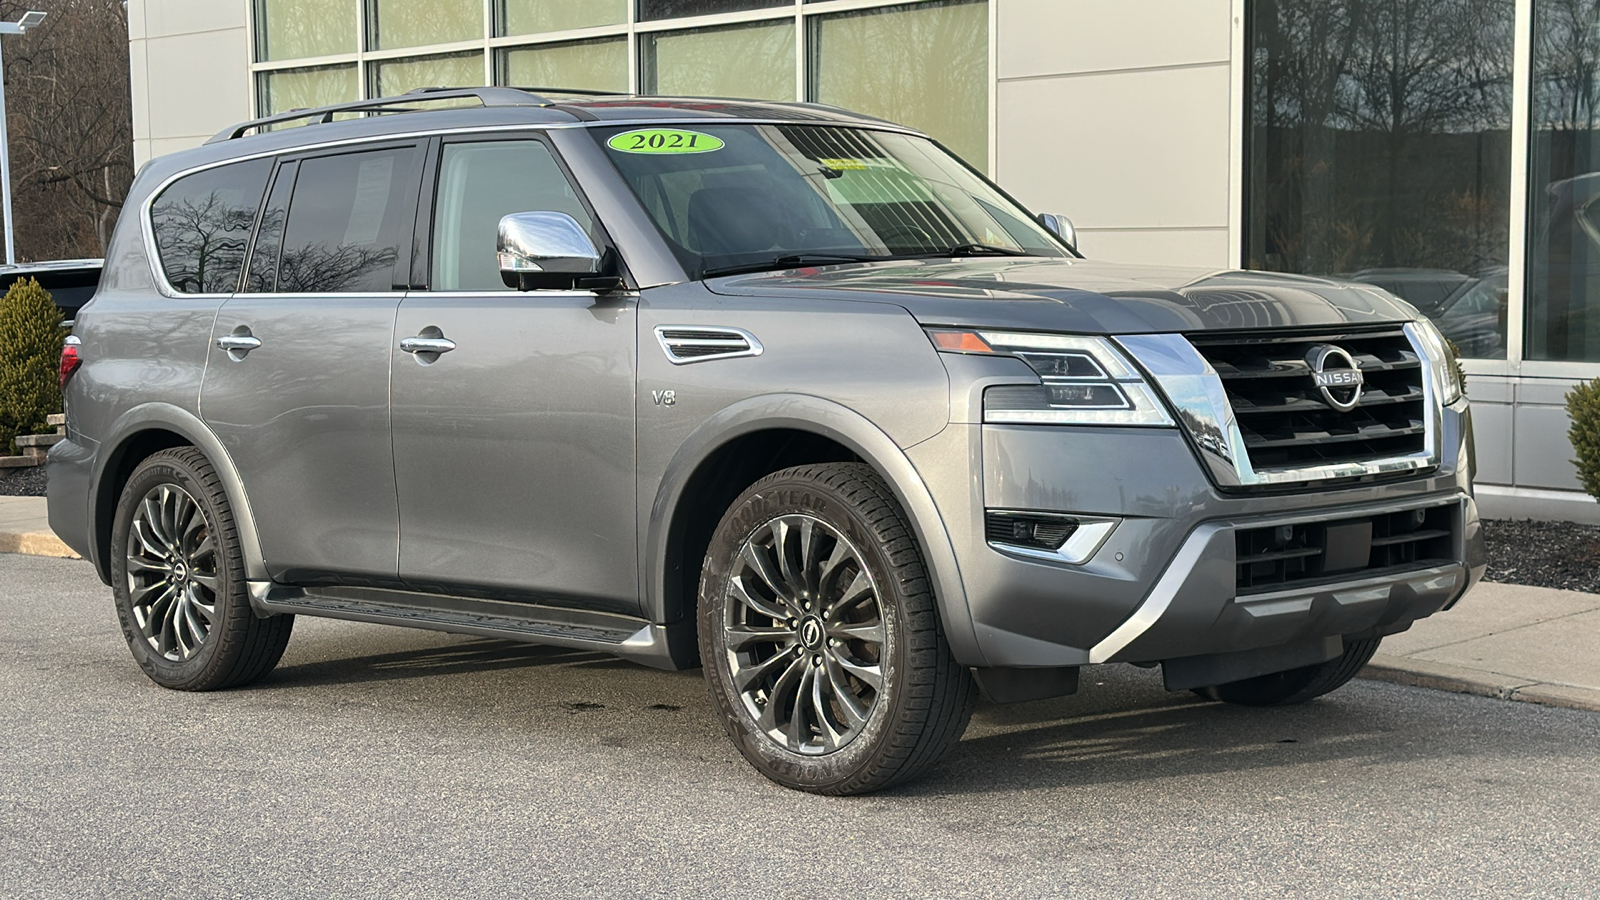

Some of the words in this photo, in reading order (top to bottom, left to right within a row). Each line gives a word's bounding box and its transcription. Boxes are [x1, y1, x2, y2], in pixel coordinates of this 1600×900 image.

[630, 133, 699, 150] 2021
[1316, 372, 1364, 385] NISSAN
[651, 390, 677, 407] V8
[722, 488, 828, 544] GOODYEAR
